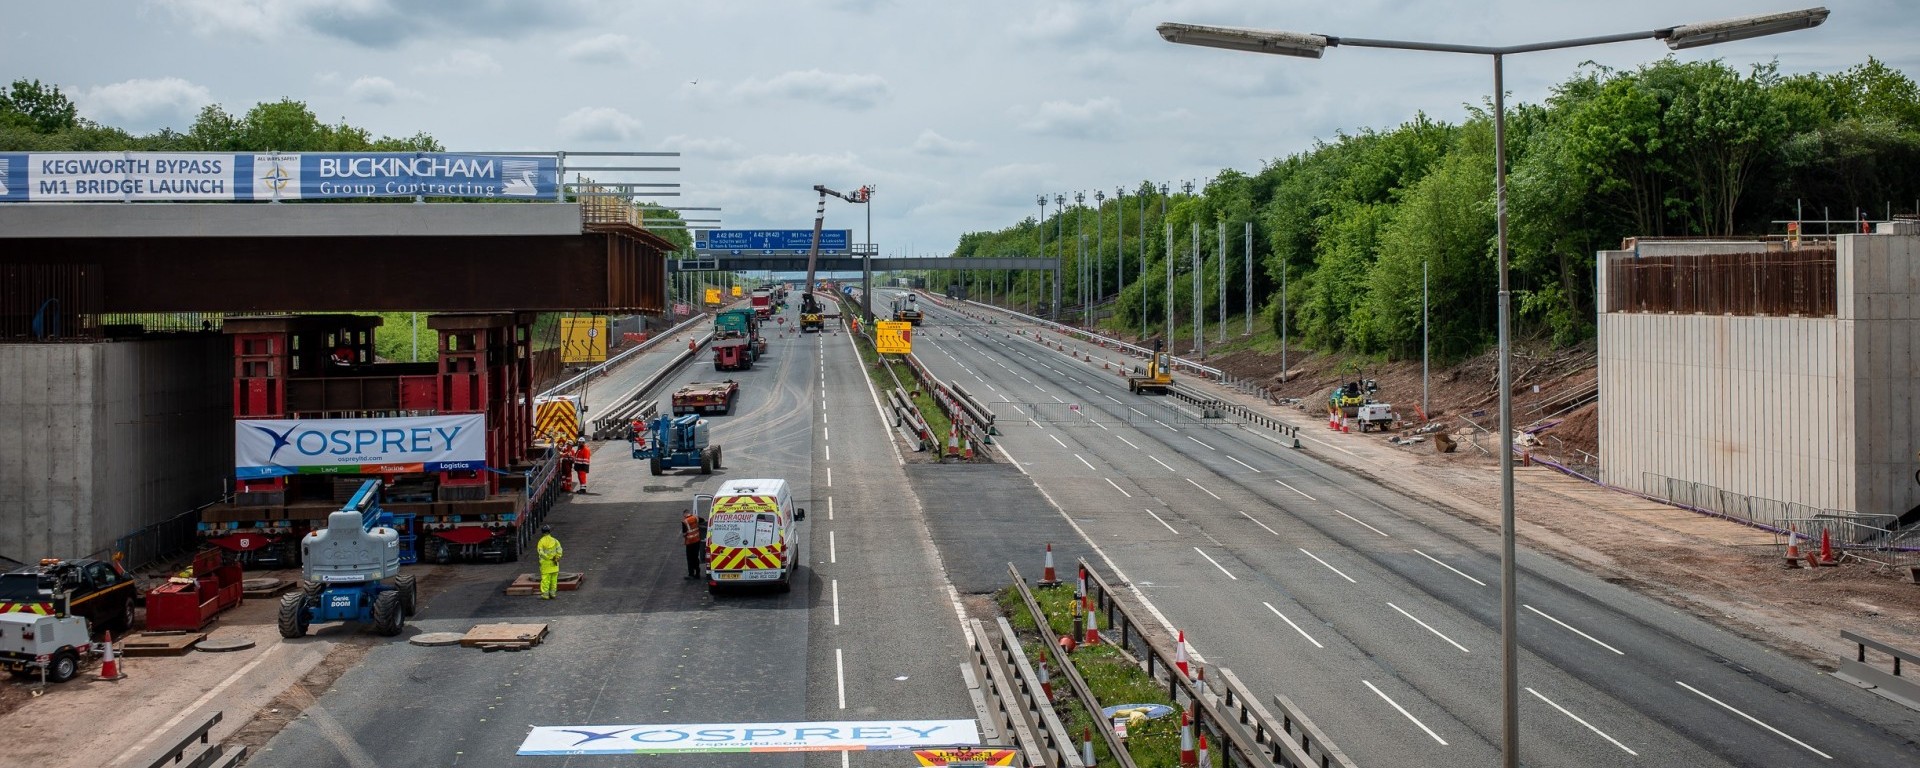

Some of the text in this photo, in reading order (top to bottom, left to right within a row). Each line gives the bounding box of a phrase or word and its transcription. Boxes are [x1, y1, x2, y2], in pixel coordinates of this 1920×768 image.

[42, 160, 222, 174] KEGWORTH BYPASS
[320, 158, 494, 178] BUCKINGHAM
[40, 180, 224, 194] M1 BRIDGE LAUNCH
[320, 182, 495, 197] Group Contracting
[296, 426, 462, 456] OSPREY
[632, 725, 946, 744] OSPREY
